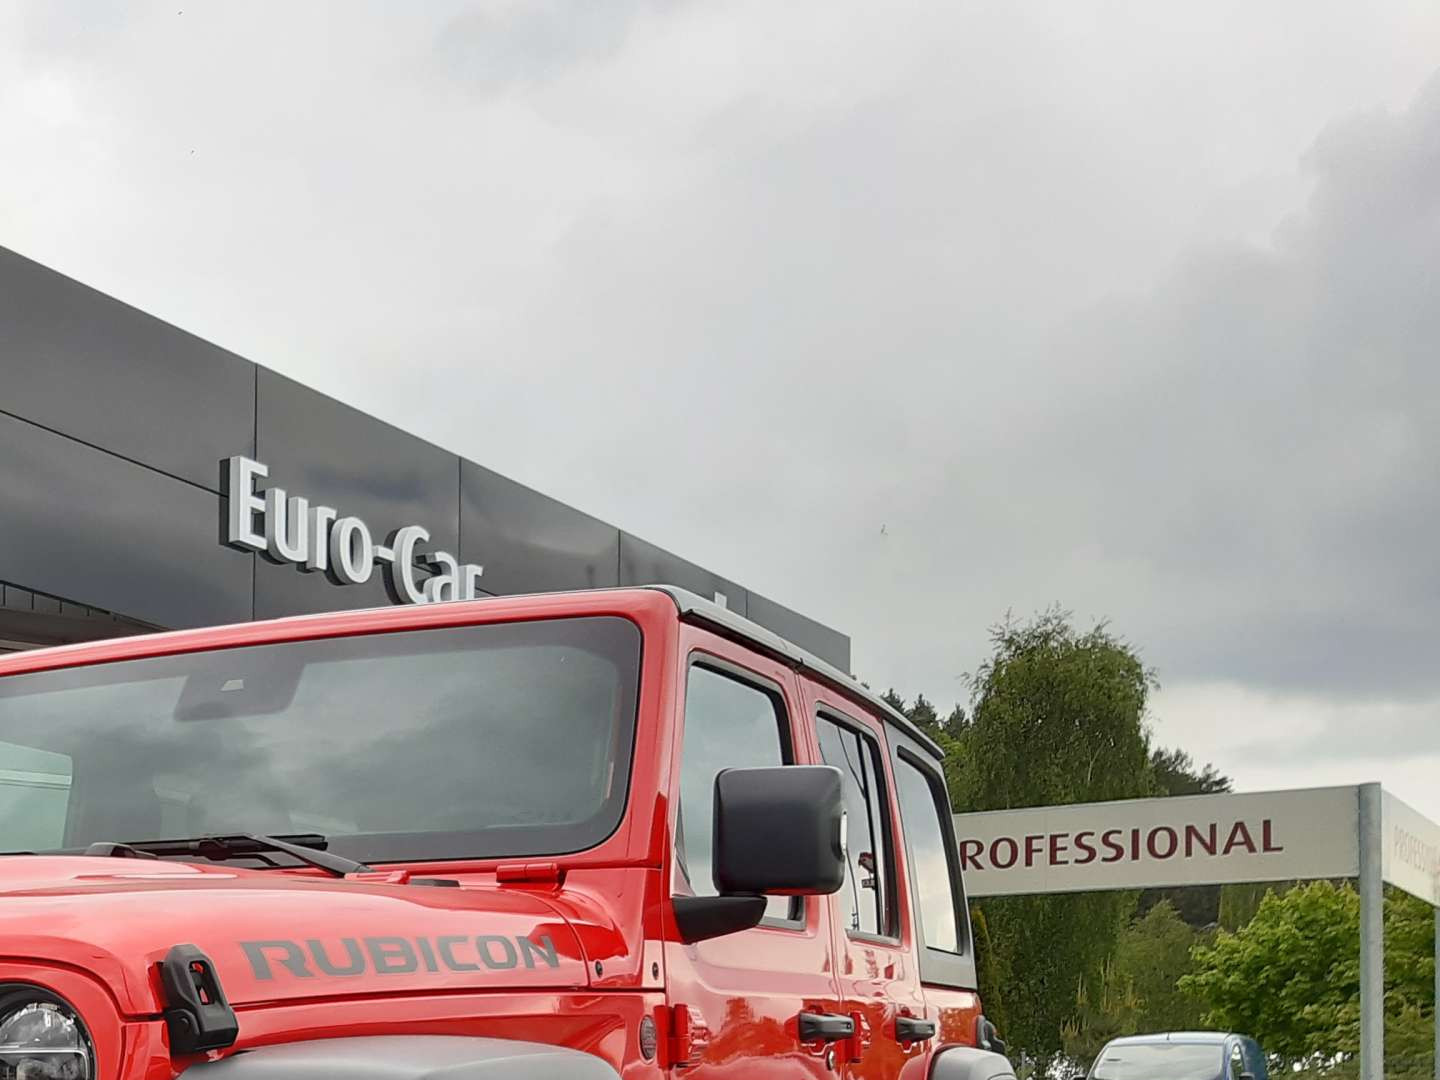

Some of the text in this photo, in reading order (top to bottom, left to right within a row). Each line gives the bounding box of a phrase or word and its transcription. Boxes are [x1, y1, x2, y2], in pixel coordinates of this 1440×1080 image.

[229, 456, 483, 604] Euro-Car
[959, 819, 1284, 871] ROFESSIONAL
[238, 934, 560, 981] RUBICON
